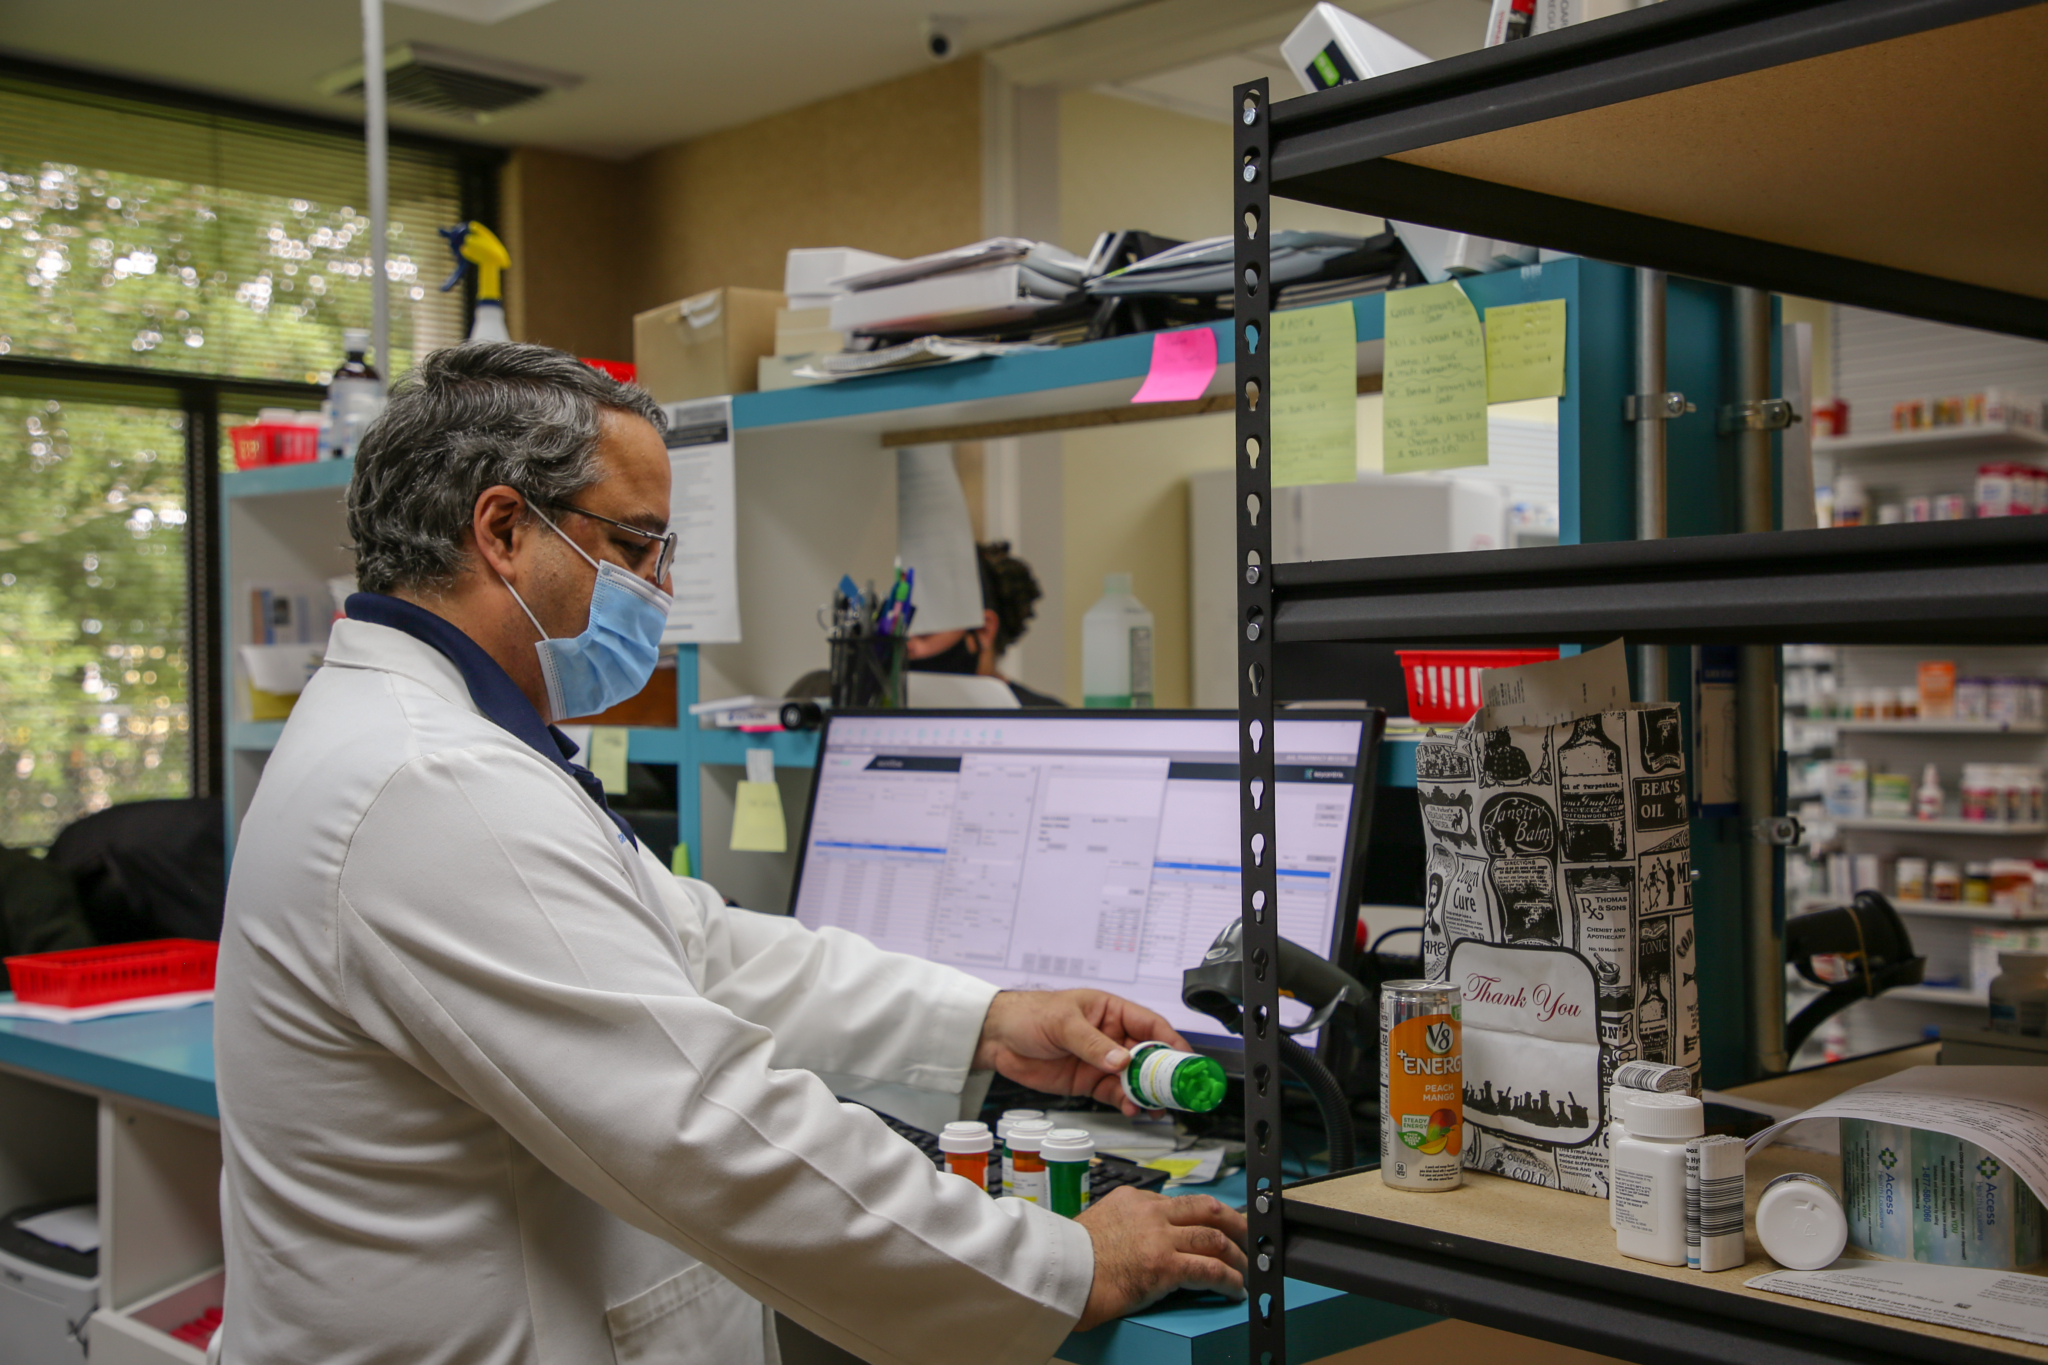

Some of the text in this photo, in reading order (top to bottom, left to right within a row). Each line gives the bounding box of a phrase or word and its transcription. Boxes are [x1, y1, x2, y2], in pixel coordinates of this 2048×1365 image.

[1641, 779, 1681, 797] BEAR'S
[1640, 803, 1665, 818] OIL
[1515, 820, 1551, 843] Balm
[1453, 887, 1477, 913] Cure
[1641, 939, 1668, 956] TONIC
[1463, 973, 1582, 1022] Thank You
[1426, 1021, 1450, 1050] V8
[1423, 1093, 1455, 1102] MANGO
[1425, 1084, 1454, 1092] PEACH
[1512, 1166, 1547, 1186] COLD
[1878, 1170, 1886, 1194] Health
[1885, 1172, 1895, 1215] Access
[1921, 1166, 1932, 1223] 1-877-580-2066
[1949, 1187, 1957, 1201] feeling
[1986, 1182, 1998, 1226] Access
[1975, 1181, 1985, 1241] Health Louisiana
